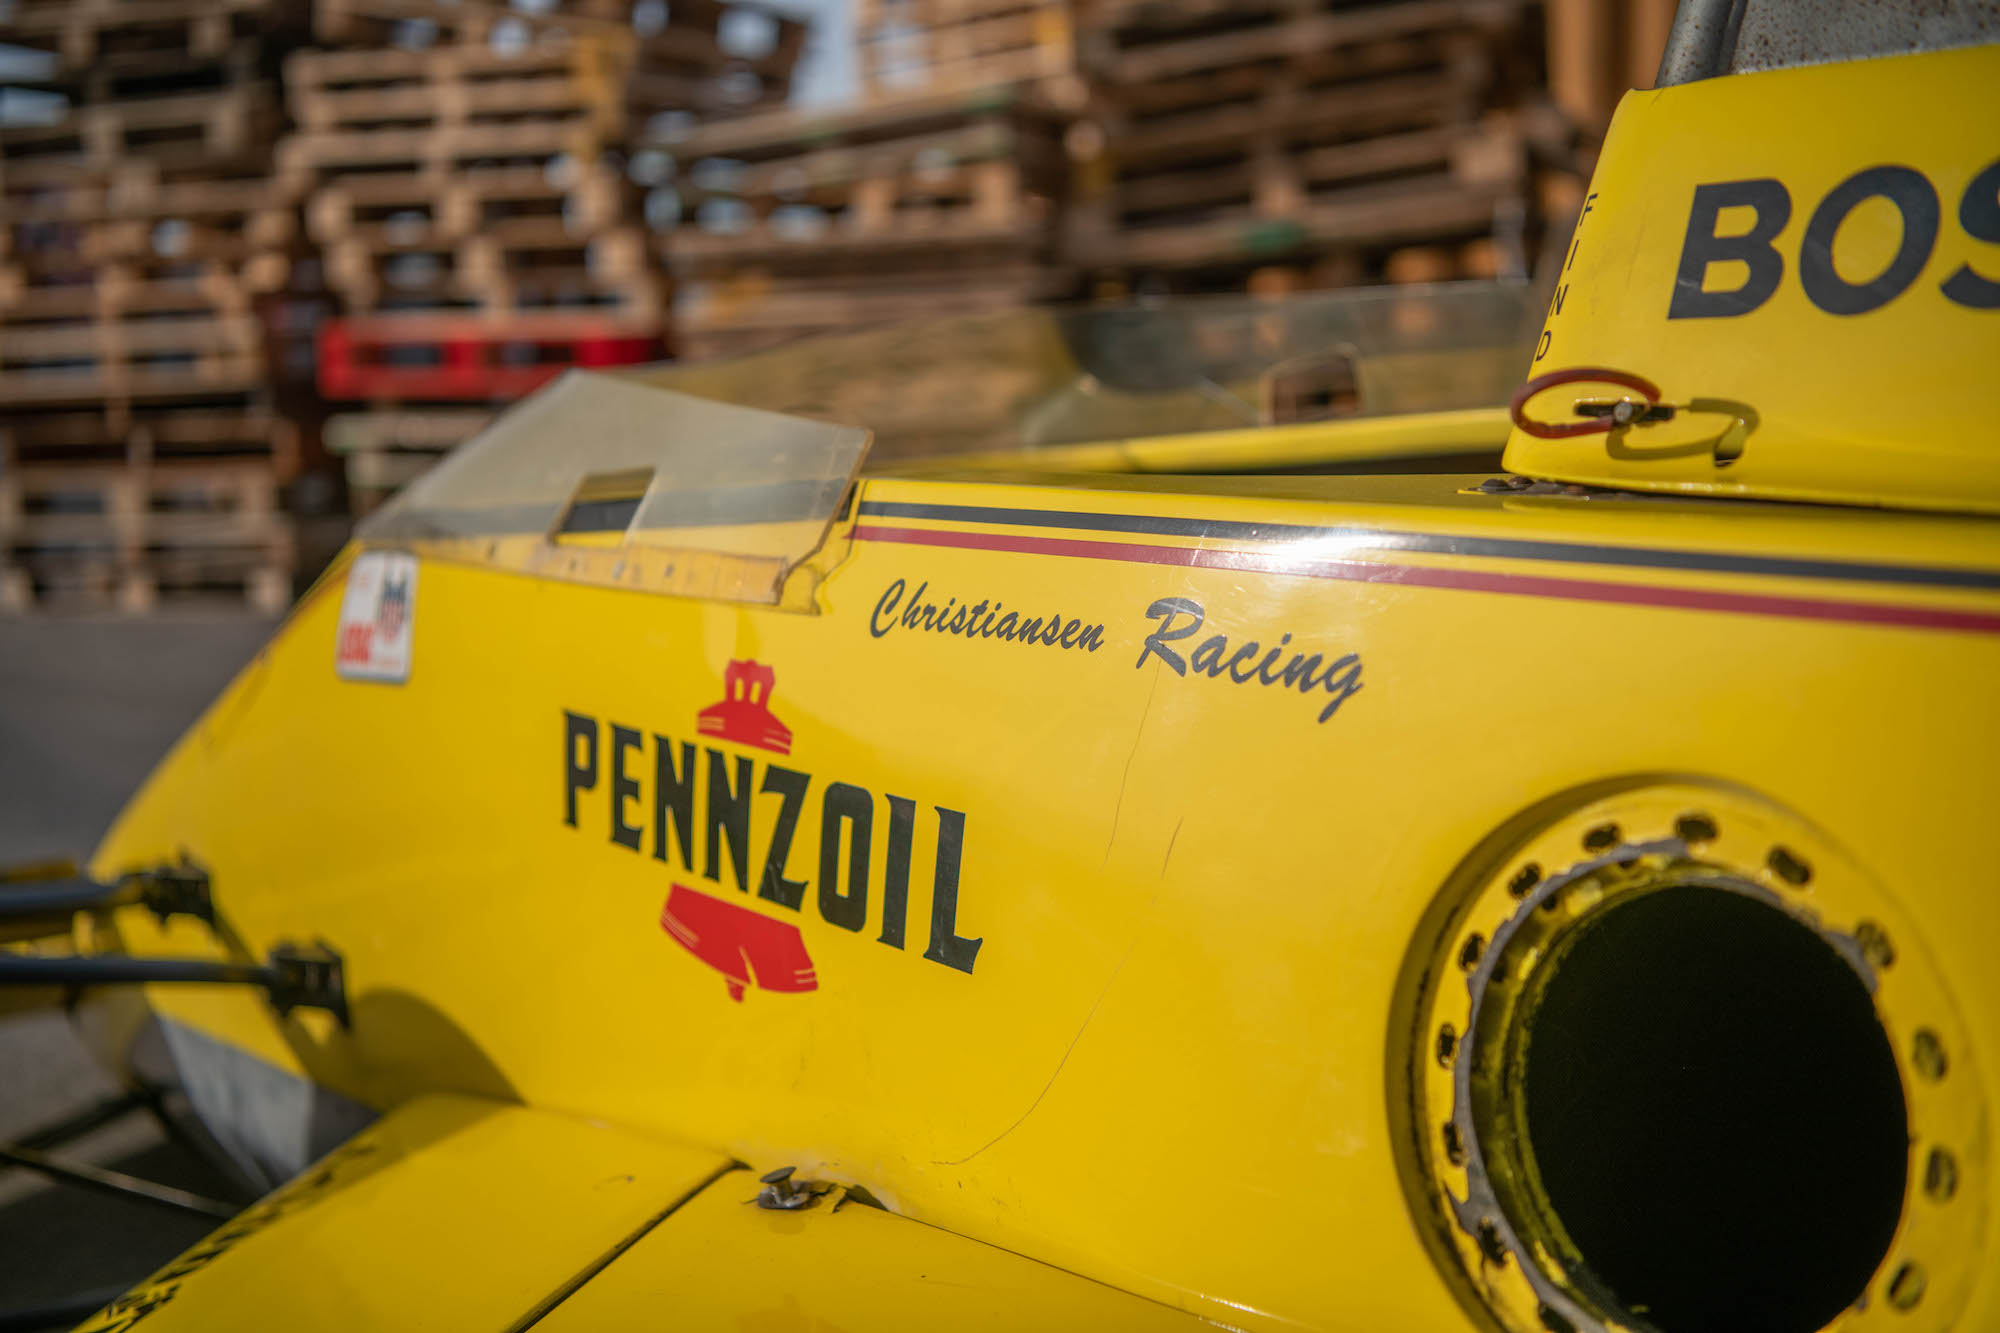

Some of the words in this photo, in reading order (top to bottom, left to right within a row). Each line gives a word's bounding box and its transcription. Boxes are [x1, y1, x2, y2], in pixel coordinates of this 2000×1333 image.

[869, 578, 1105, 652] Christiansen
[1136, 597, 1364, 723] Racing
[562, 708, 983, 975] PENNZOIL
